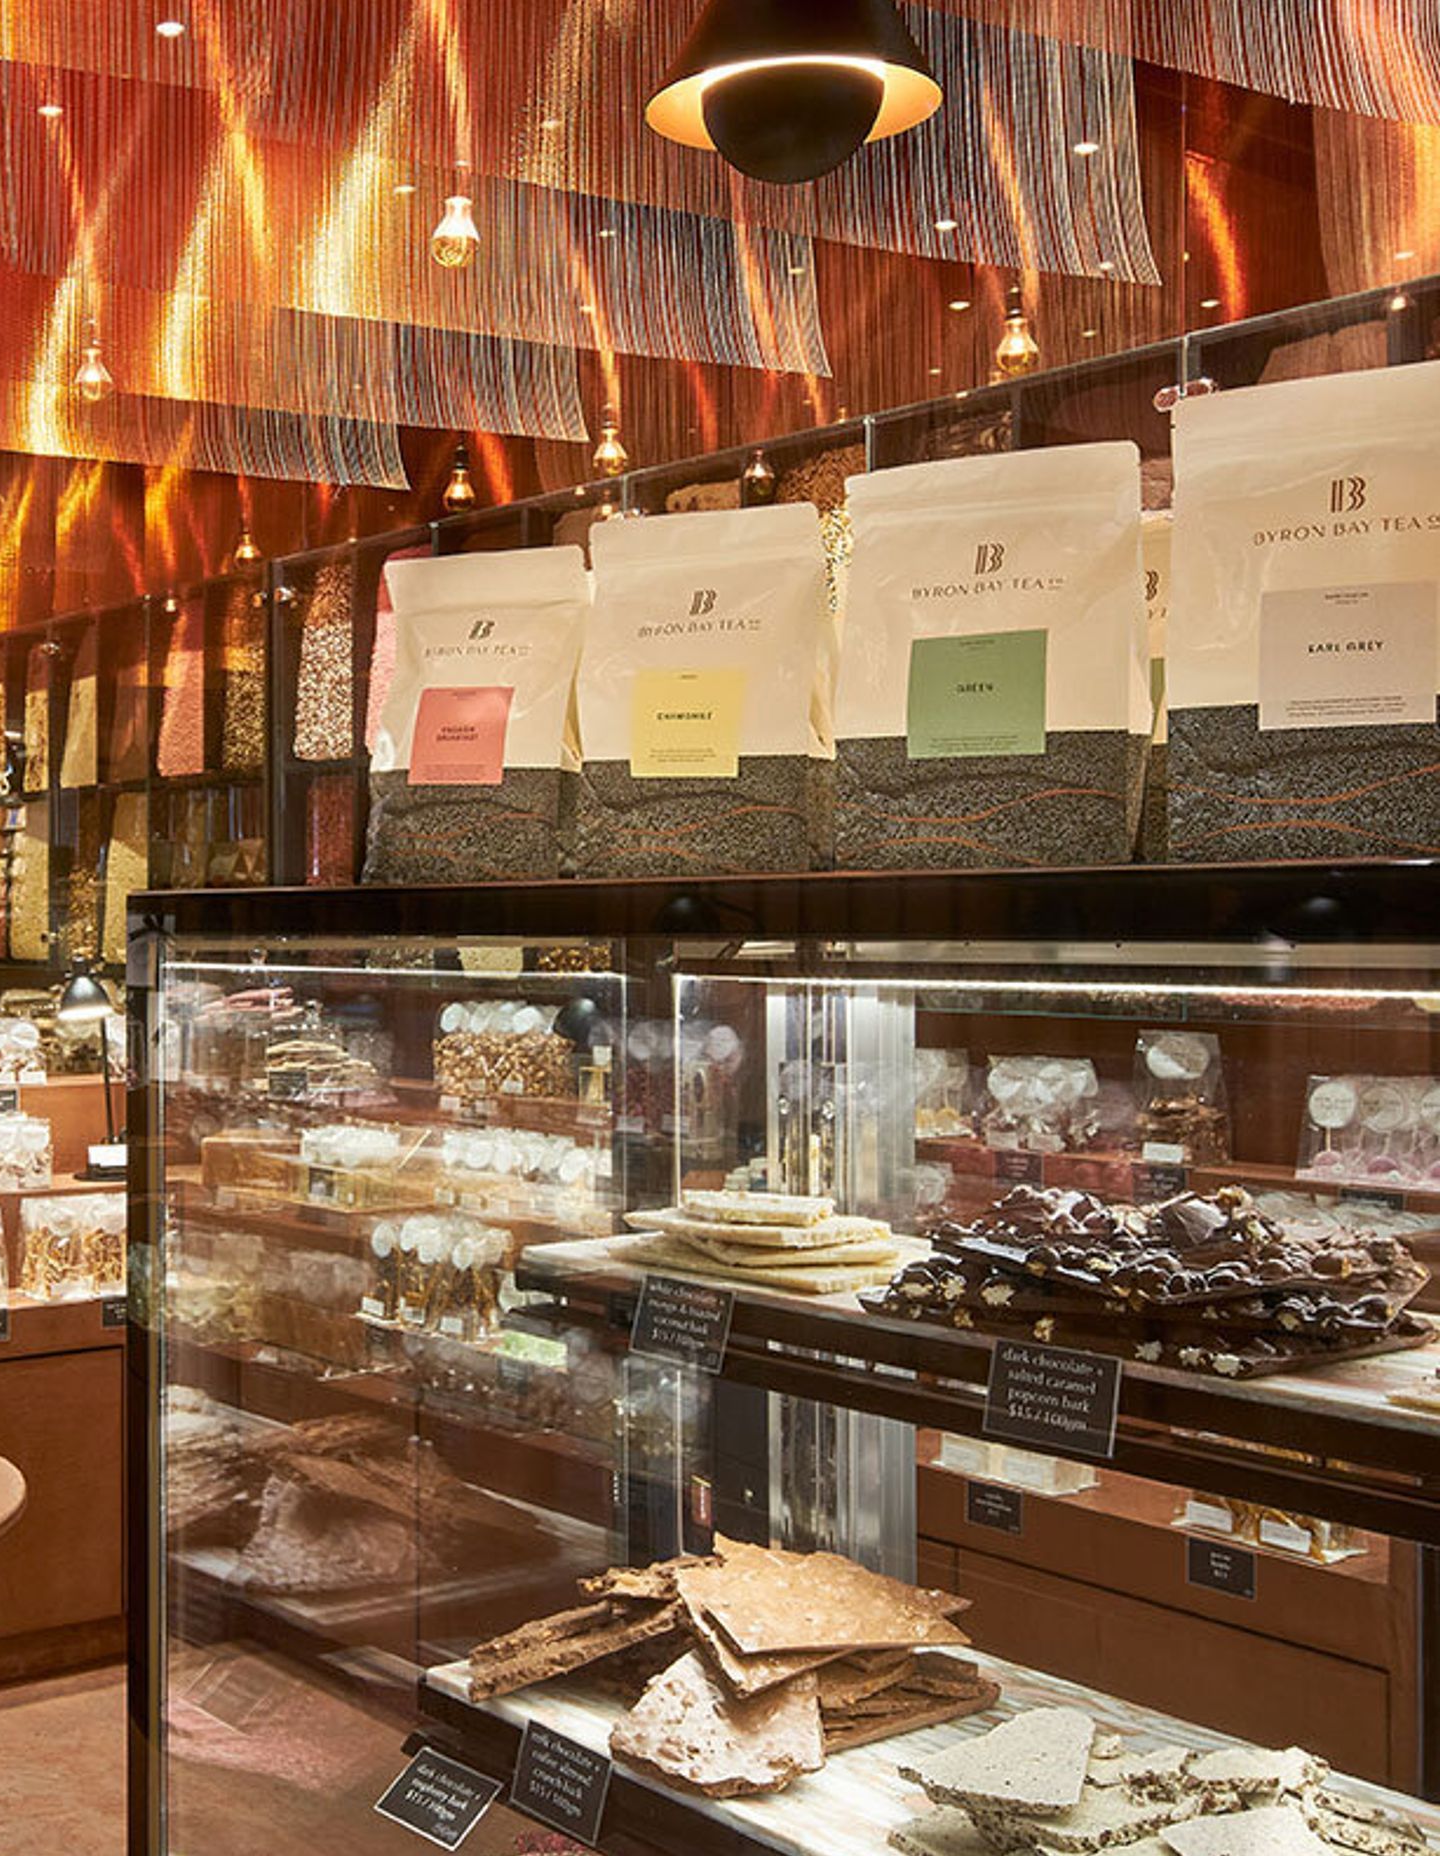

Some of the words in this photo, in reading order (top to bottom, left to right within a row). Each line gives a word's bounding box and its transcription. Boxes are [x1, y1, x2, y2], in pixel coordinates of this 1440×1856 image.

[1252, 524, 1327, 547] BYRON
[1333, 518, 1374, 539] BAY
[1380, 516, 1422, 533] TEA
[911, 583, 969, 600] BYRON
[973, 580, 1005, 595] BAY
[1012, 577, 1045, 591] TEA
[718, 618, 747, 631] TEA
[1307, 643, 1342, 654] EARL
[1345, 640, 1385, 652] GREY
[1001, 1347, 1030, 1364] dark
[1031, 1353, 1095, 1375] chocolate
[1008, 1368, 1045, 1386] salted
[1046, 1376, 1097, 1396] caramel
[1007, 1387, 1060, 1407] popcorn
[1061, 1394, 1090, 1413] bark
